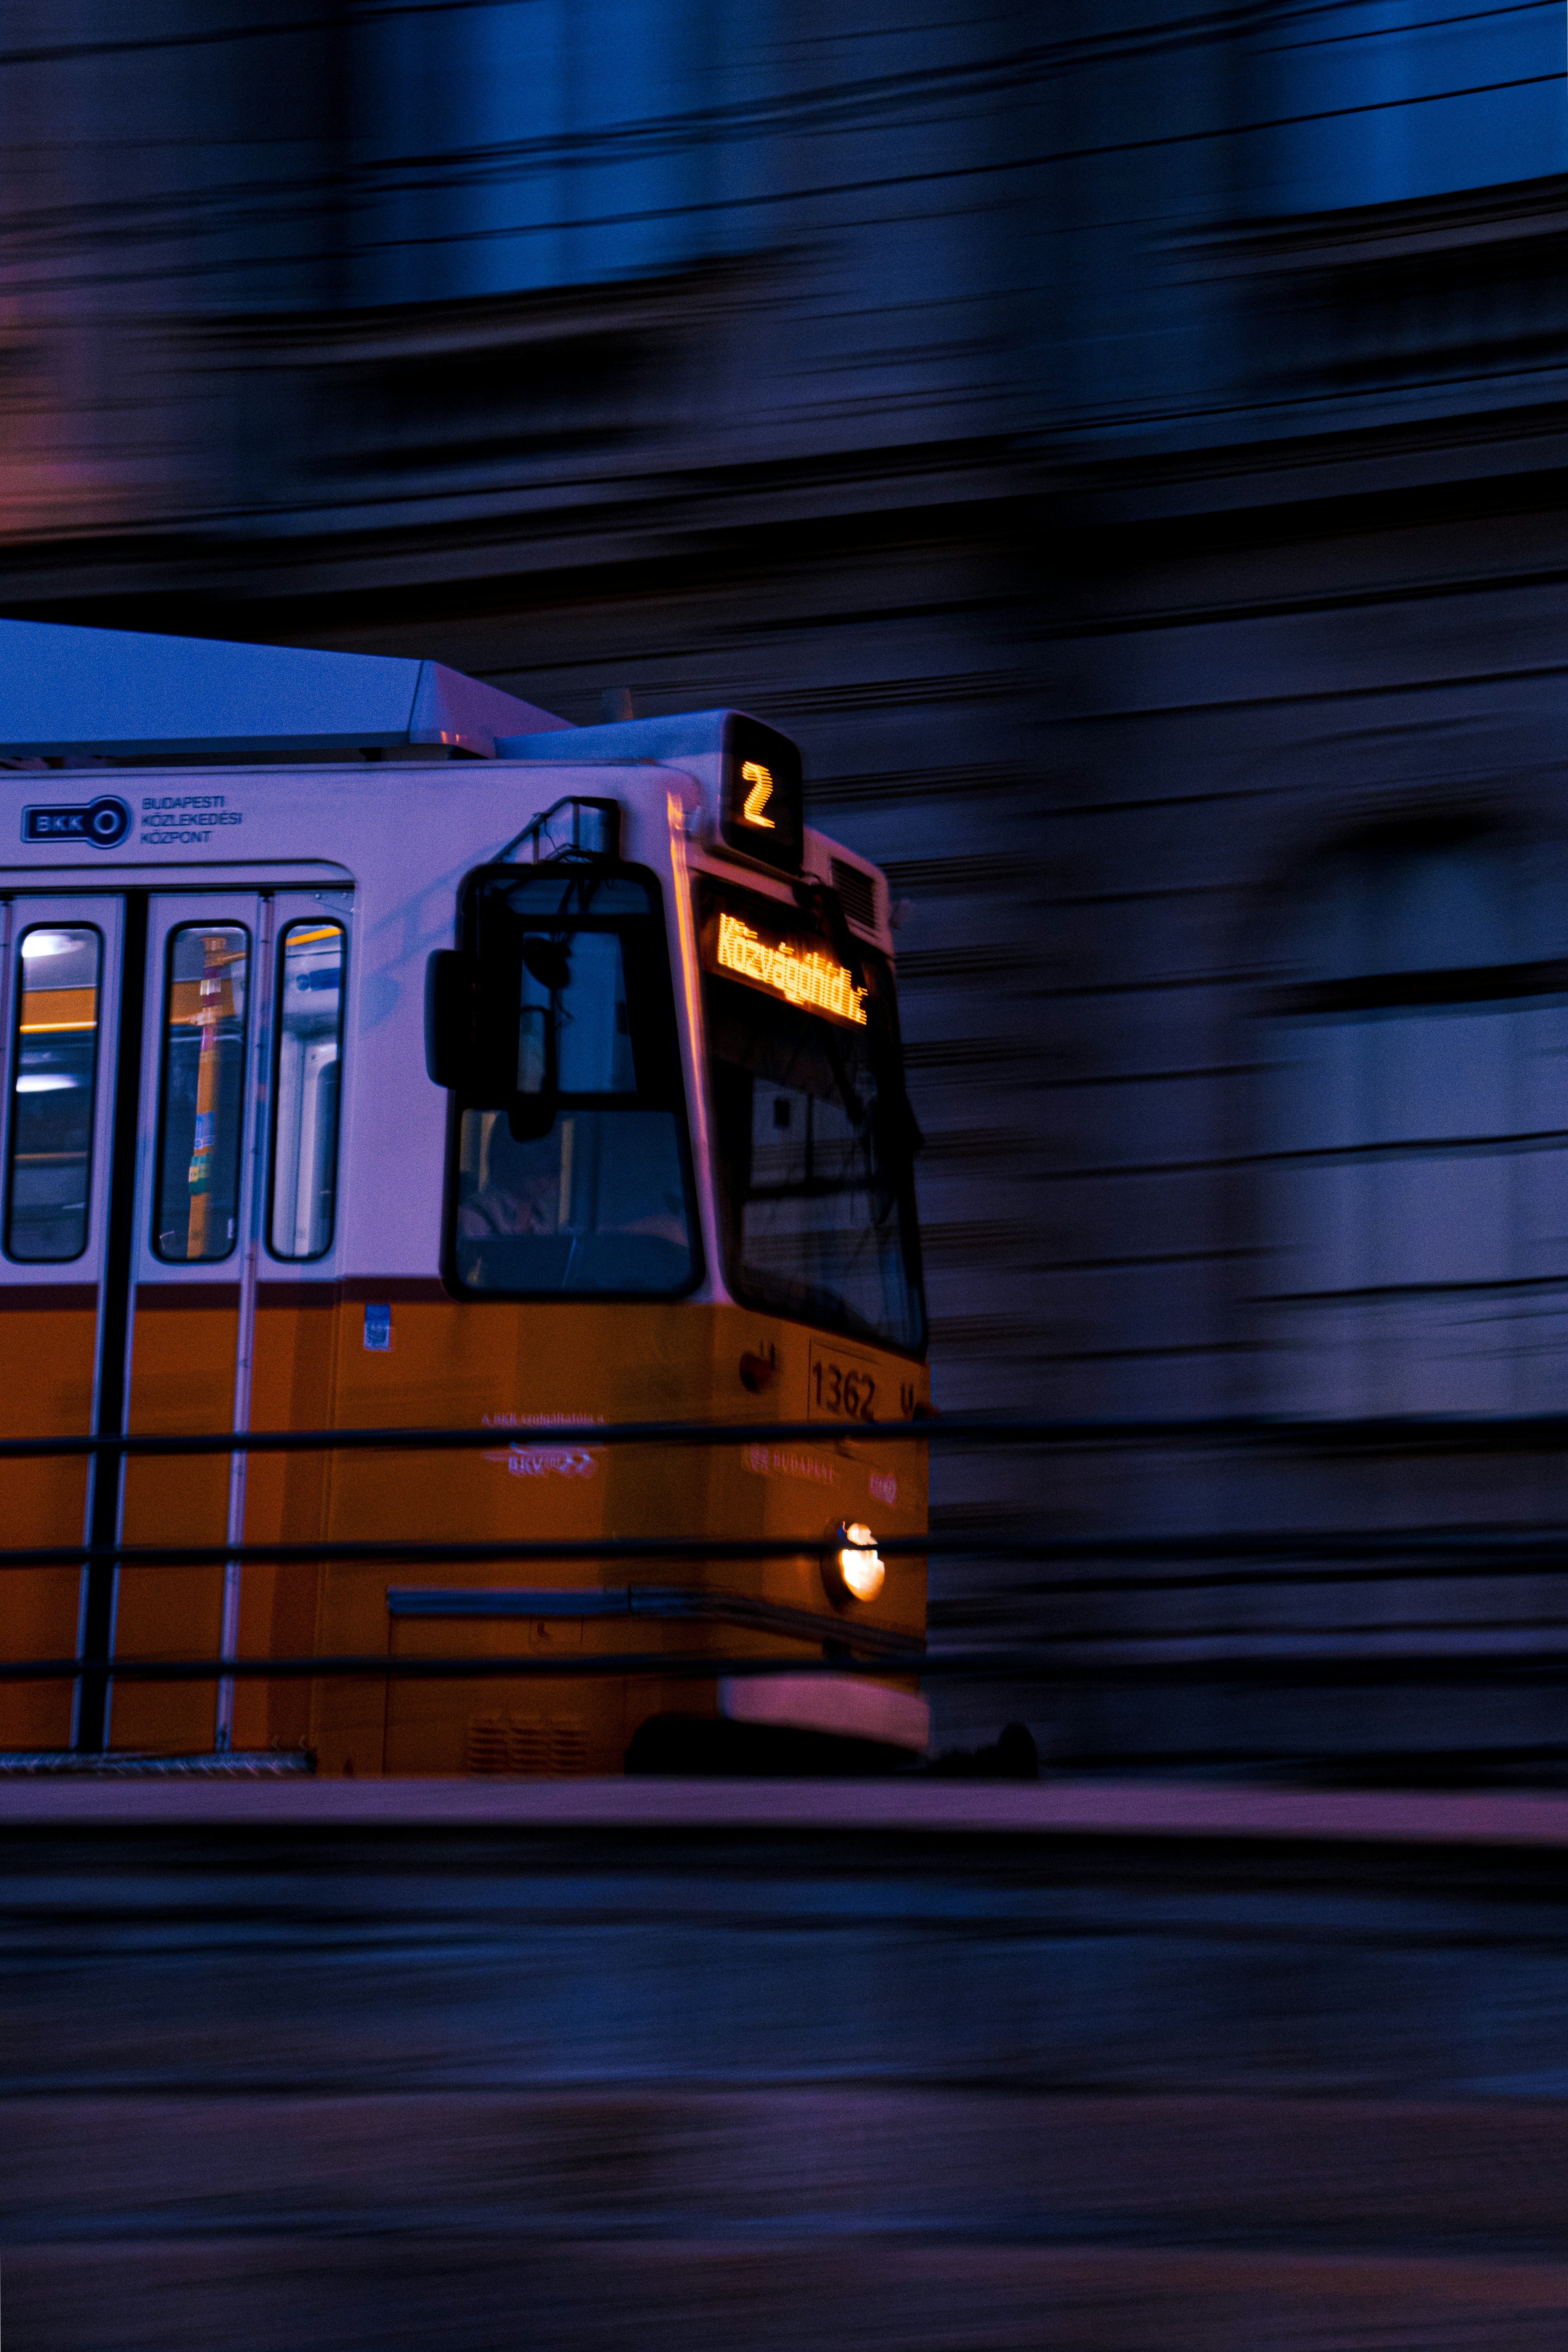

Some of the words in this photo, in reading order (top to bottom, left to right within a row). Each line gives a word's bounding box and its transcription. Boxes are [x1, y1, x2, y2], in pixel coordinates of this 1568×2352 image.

[142, 796, 225, 810] BUDAPESTI
[742, 761, 775, 829] 2
[36, 815, 84, 832] BKK
[141, 810, 243, 827] KÖZLEKEDÉSI
[140, 829, 213, 845] KÖZPONT
[813, 1360, 875, 1421] 1362
